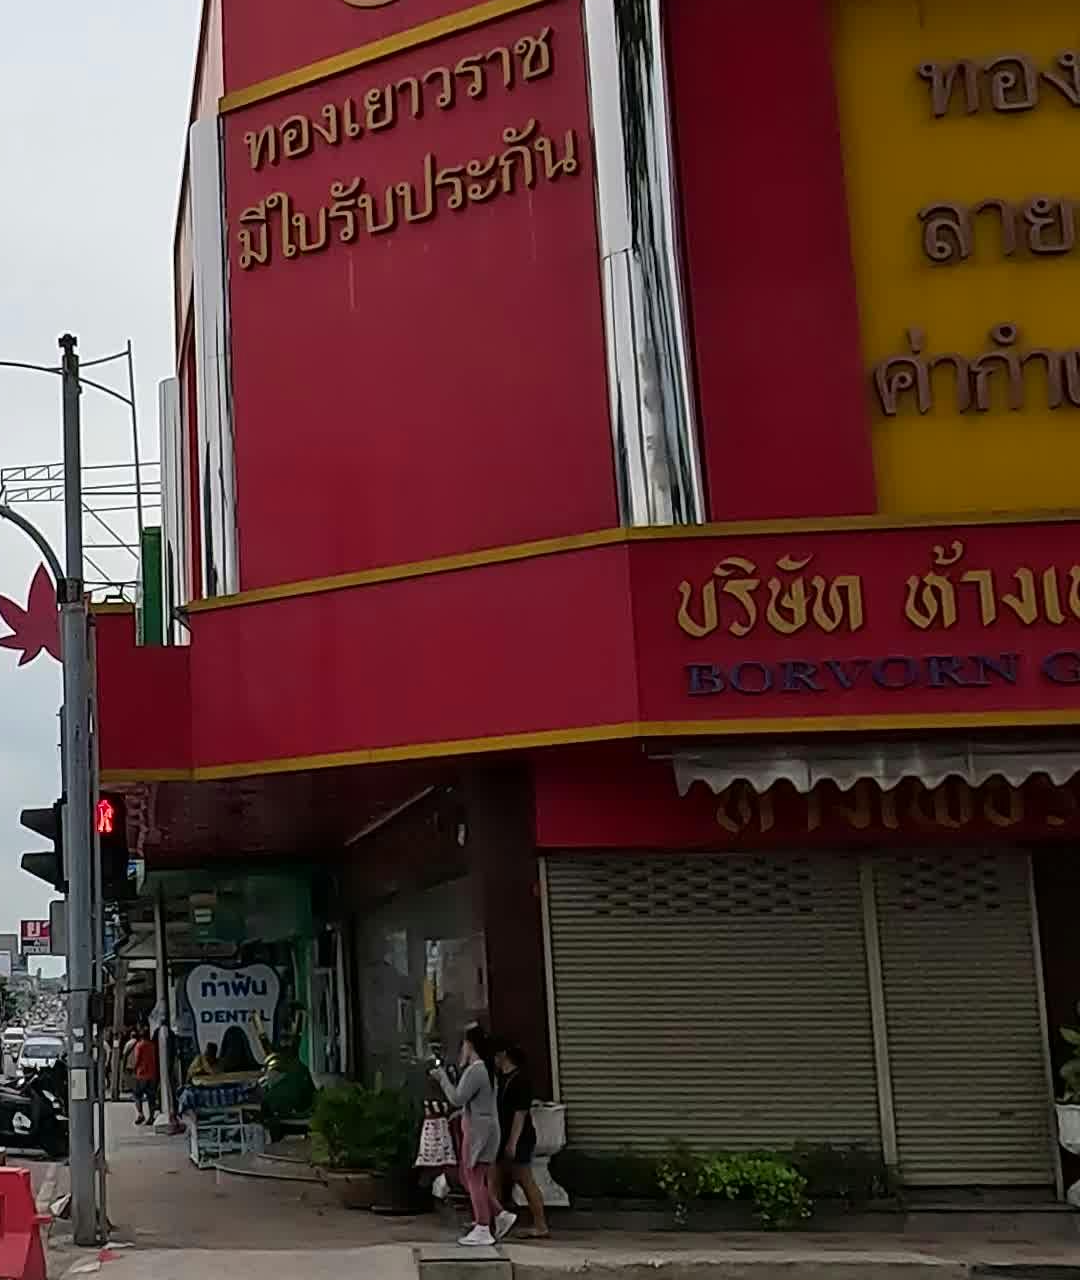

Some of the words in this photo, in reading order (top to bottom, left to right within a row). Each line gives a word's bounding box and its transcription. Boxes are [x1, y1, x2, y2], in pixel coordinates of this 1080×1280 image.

[243, 26, 554, 170] ทองเยาวราช
[237, 118, 579, 270] มีใบรับประกัน
[675, 551, 865, 638] บริษัท
[904, 538, 1080, 631] ห้างเ
[685, 650, 1021, 697] BORVORN
[201, 972, 267, 997] ทำฟัน
